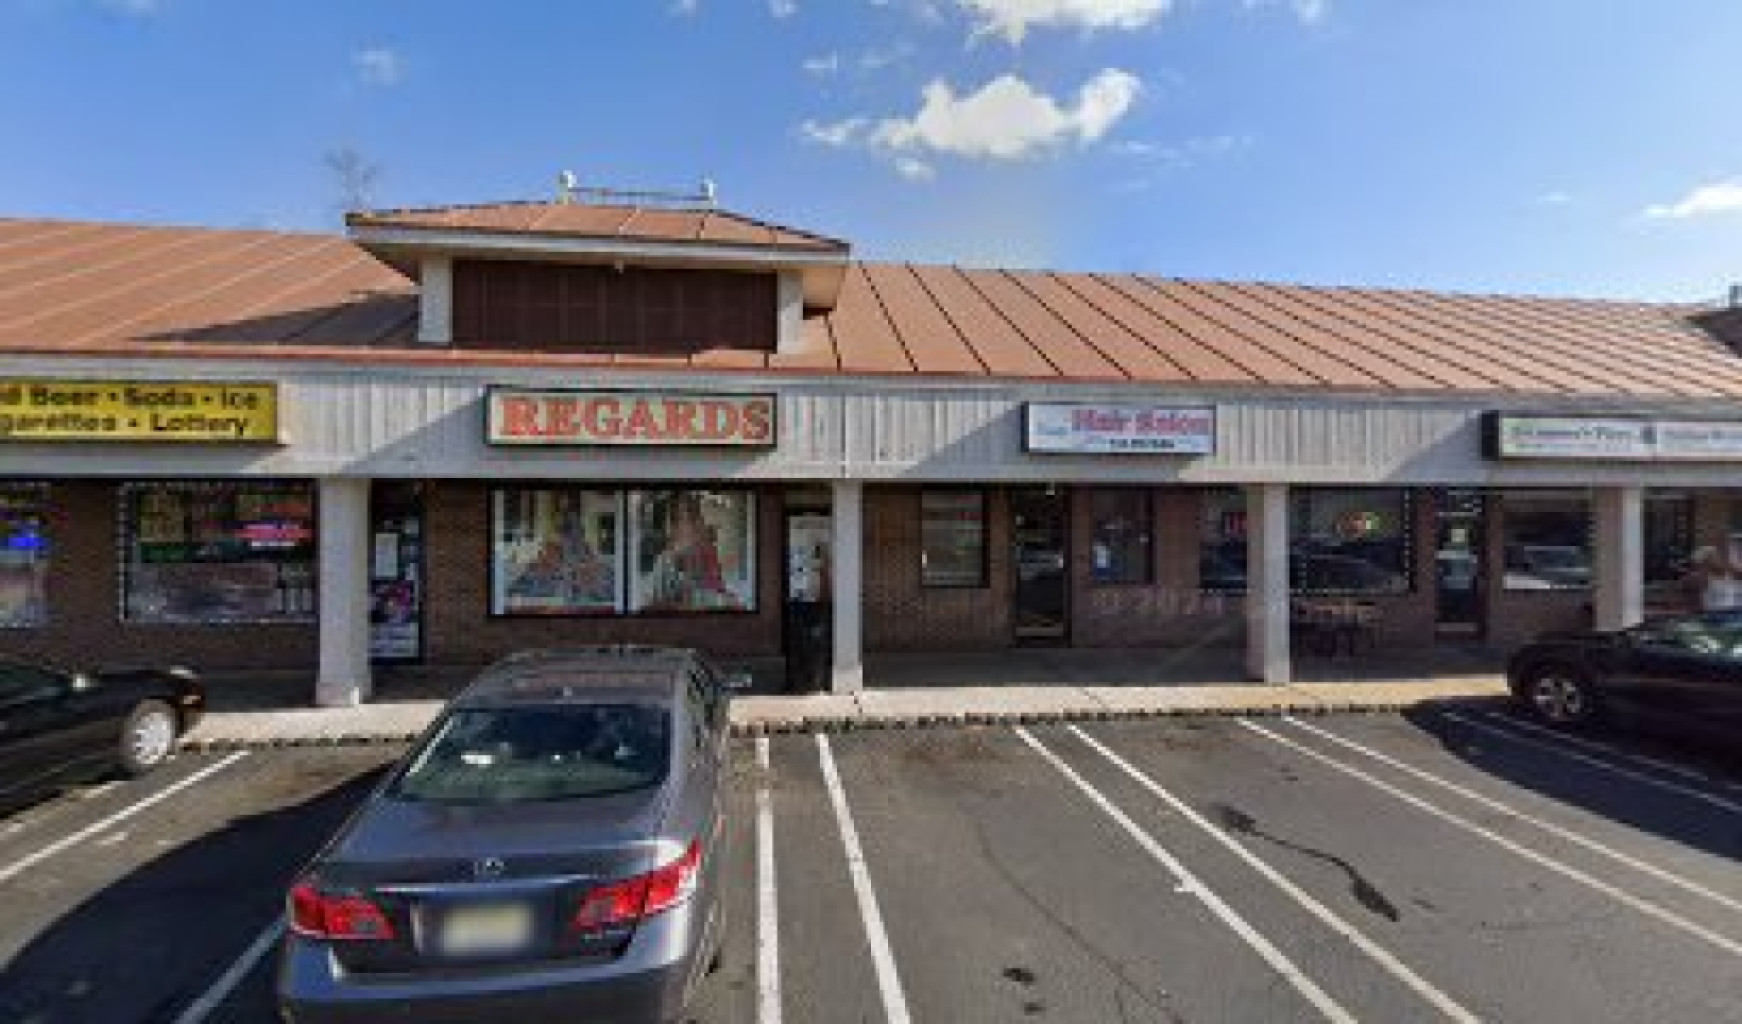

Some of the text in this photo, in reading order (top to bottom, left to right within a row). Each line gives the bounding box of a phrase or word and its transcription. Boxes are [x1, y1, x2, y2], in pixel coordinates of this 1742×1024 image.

[29, 387, 98, 407] Beer
[123, 387, 195, 409] Soda
[221, 387, 258, 410] Ice
[152, 414, 248, 436] Lottery
[502, 397, 770, 440] REGARDS
[1071, 409, 1132, 432] Hair
[1136, 411, 1210, 436] Salon
